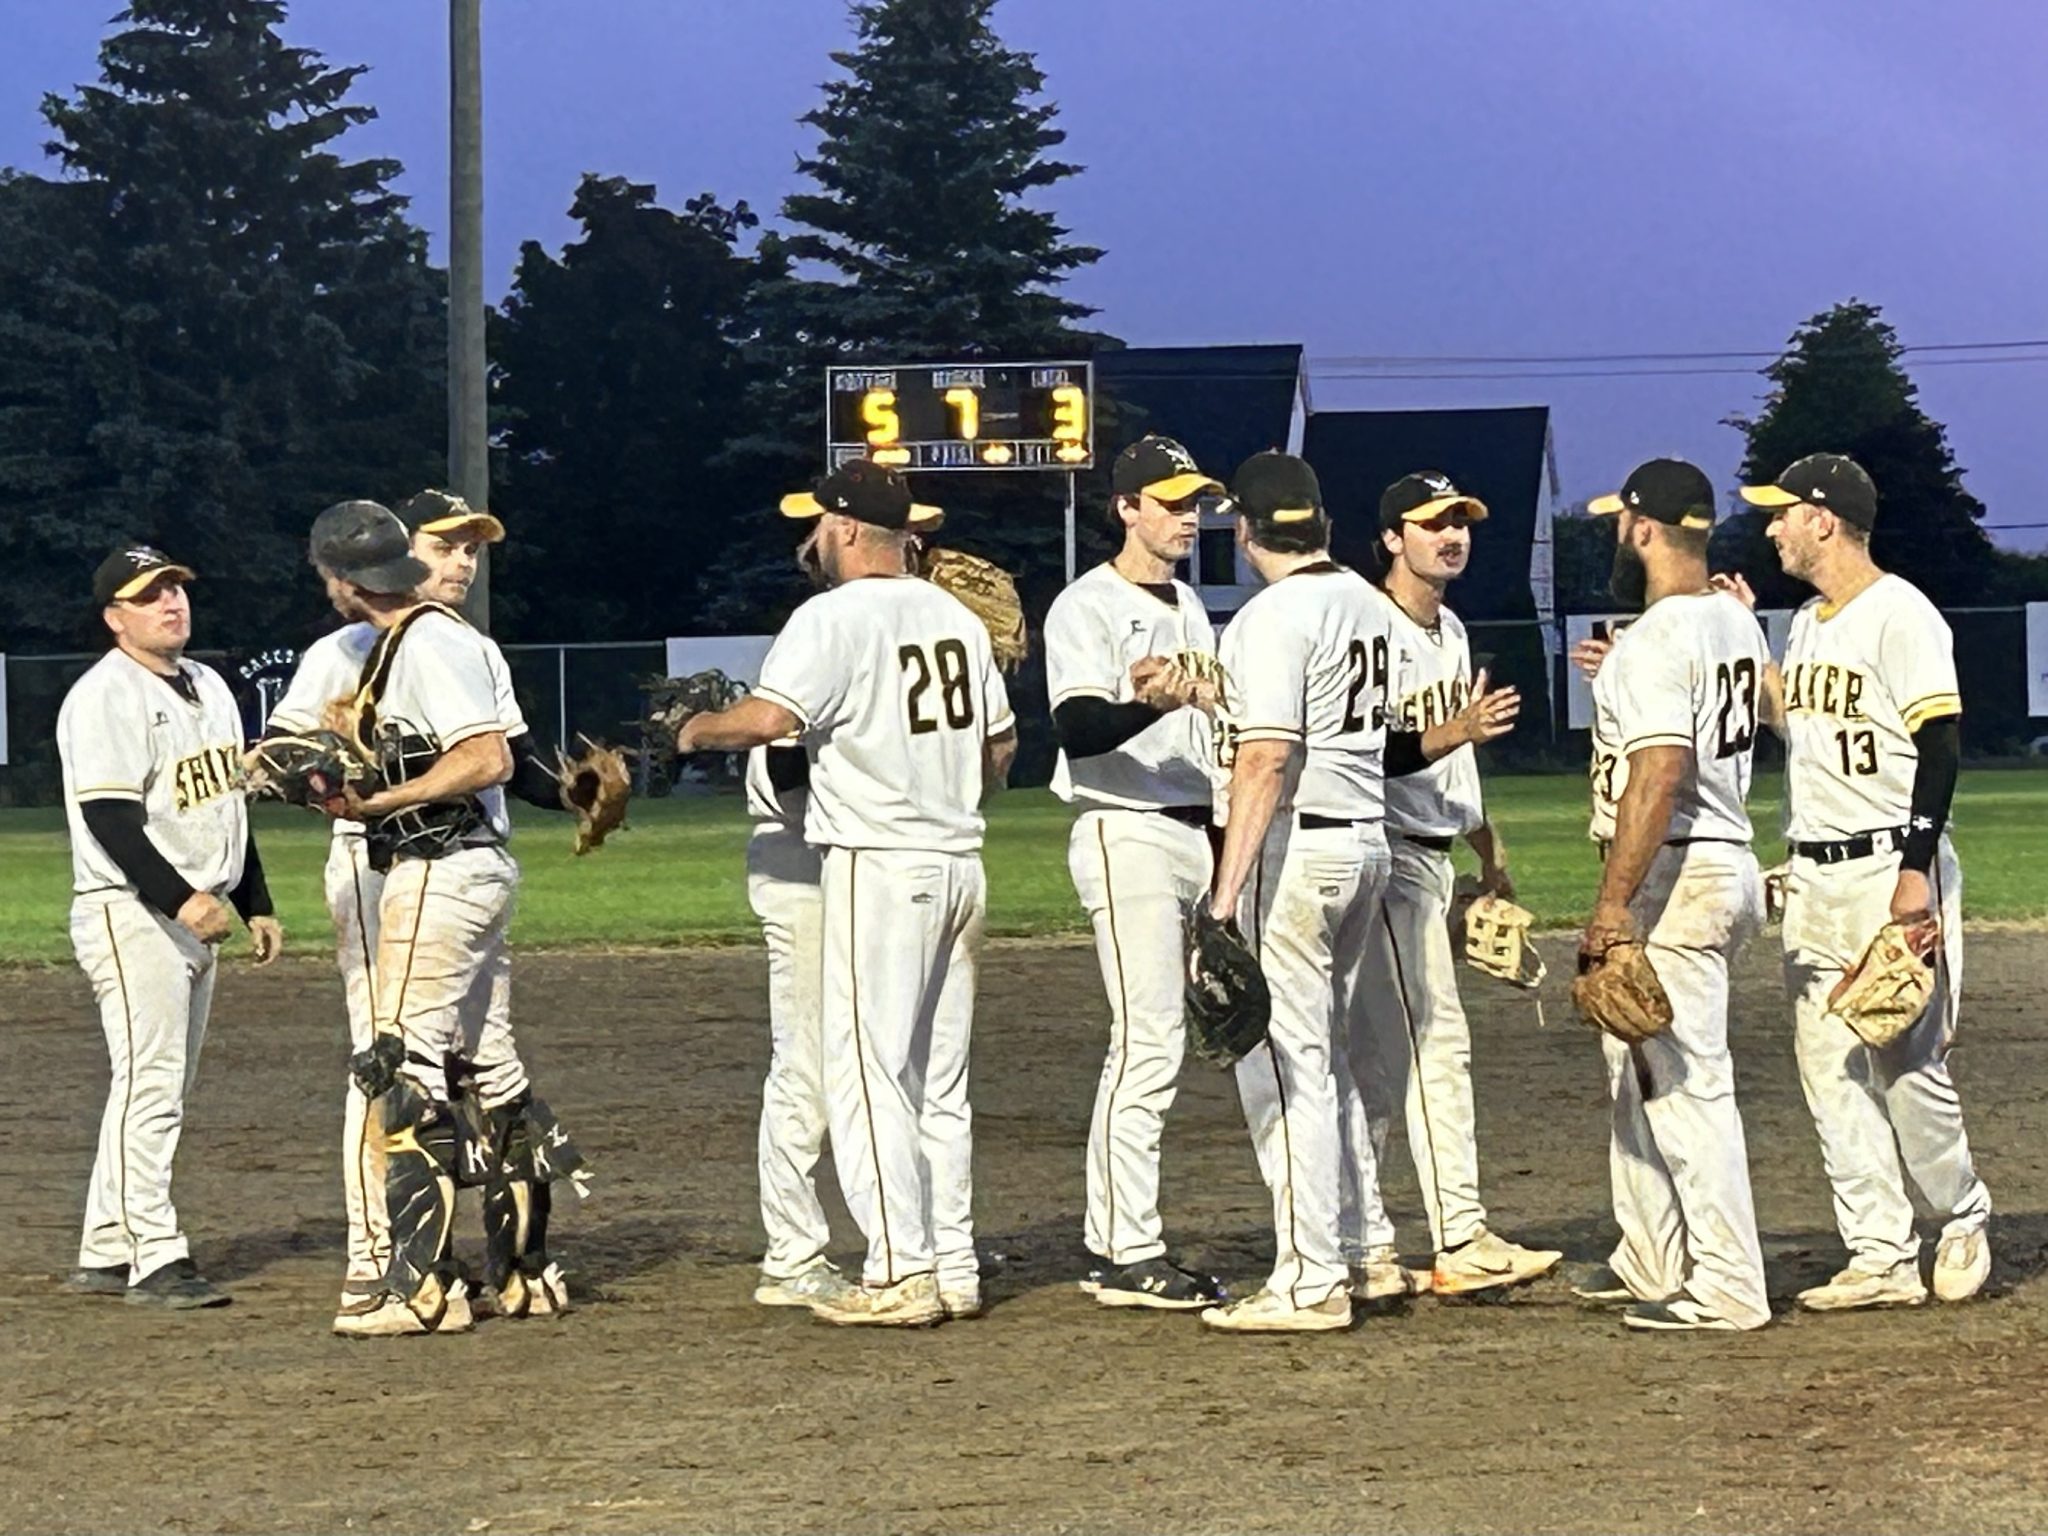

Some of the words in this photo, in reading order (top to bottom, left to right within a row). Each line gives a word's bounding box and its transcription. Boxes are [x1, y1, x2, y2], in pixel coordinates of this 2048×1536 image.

[863, 389, 899, 444] 5
[1052, 386, 1085, 439] 3
[899, 638, 974, 734] 28
[1342, 635, 1389, 732] 29
[1715, 657, 1755, 759] 23
[1835, 728, 1878, 777] 13
